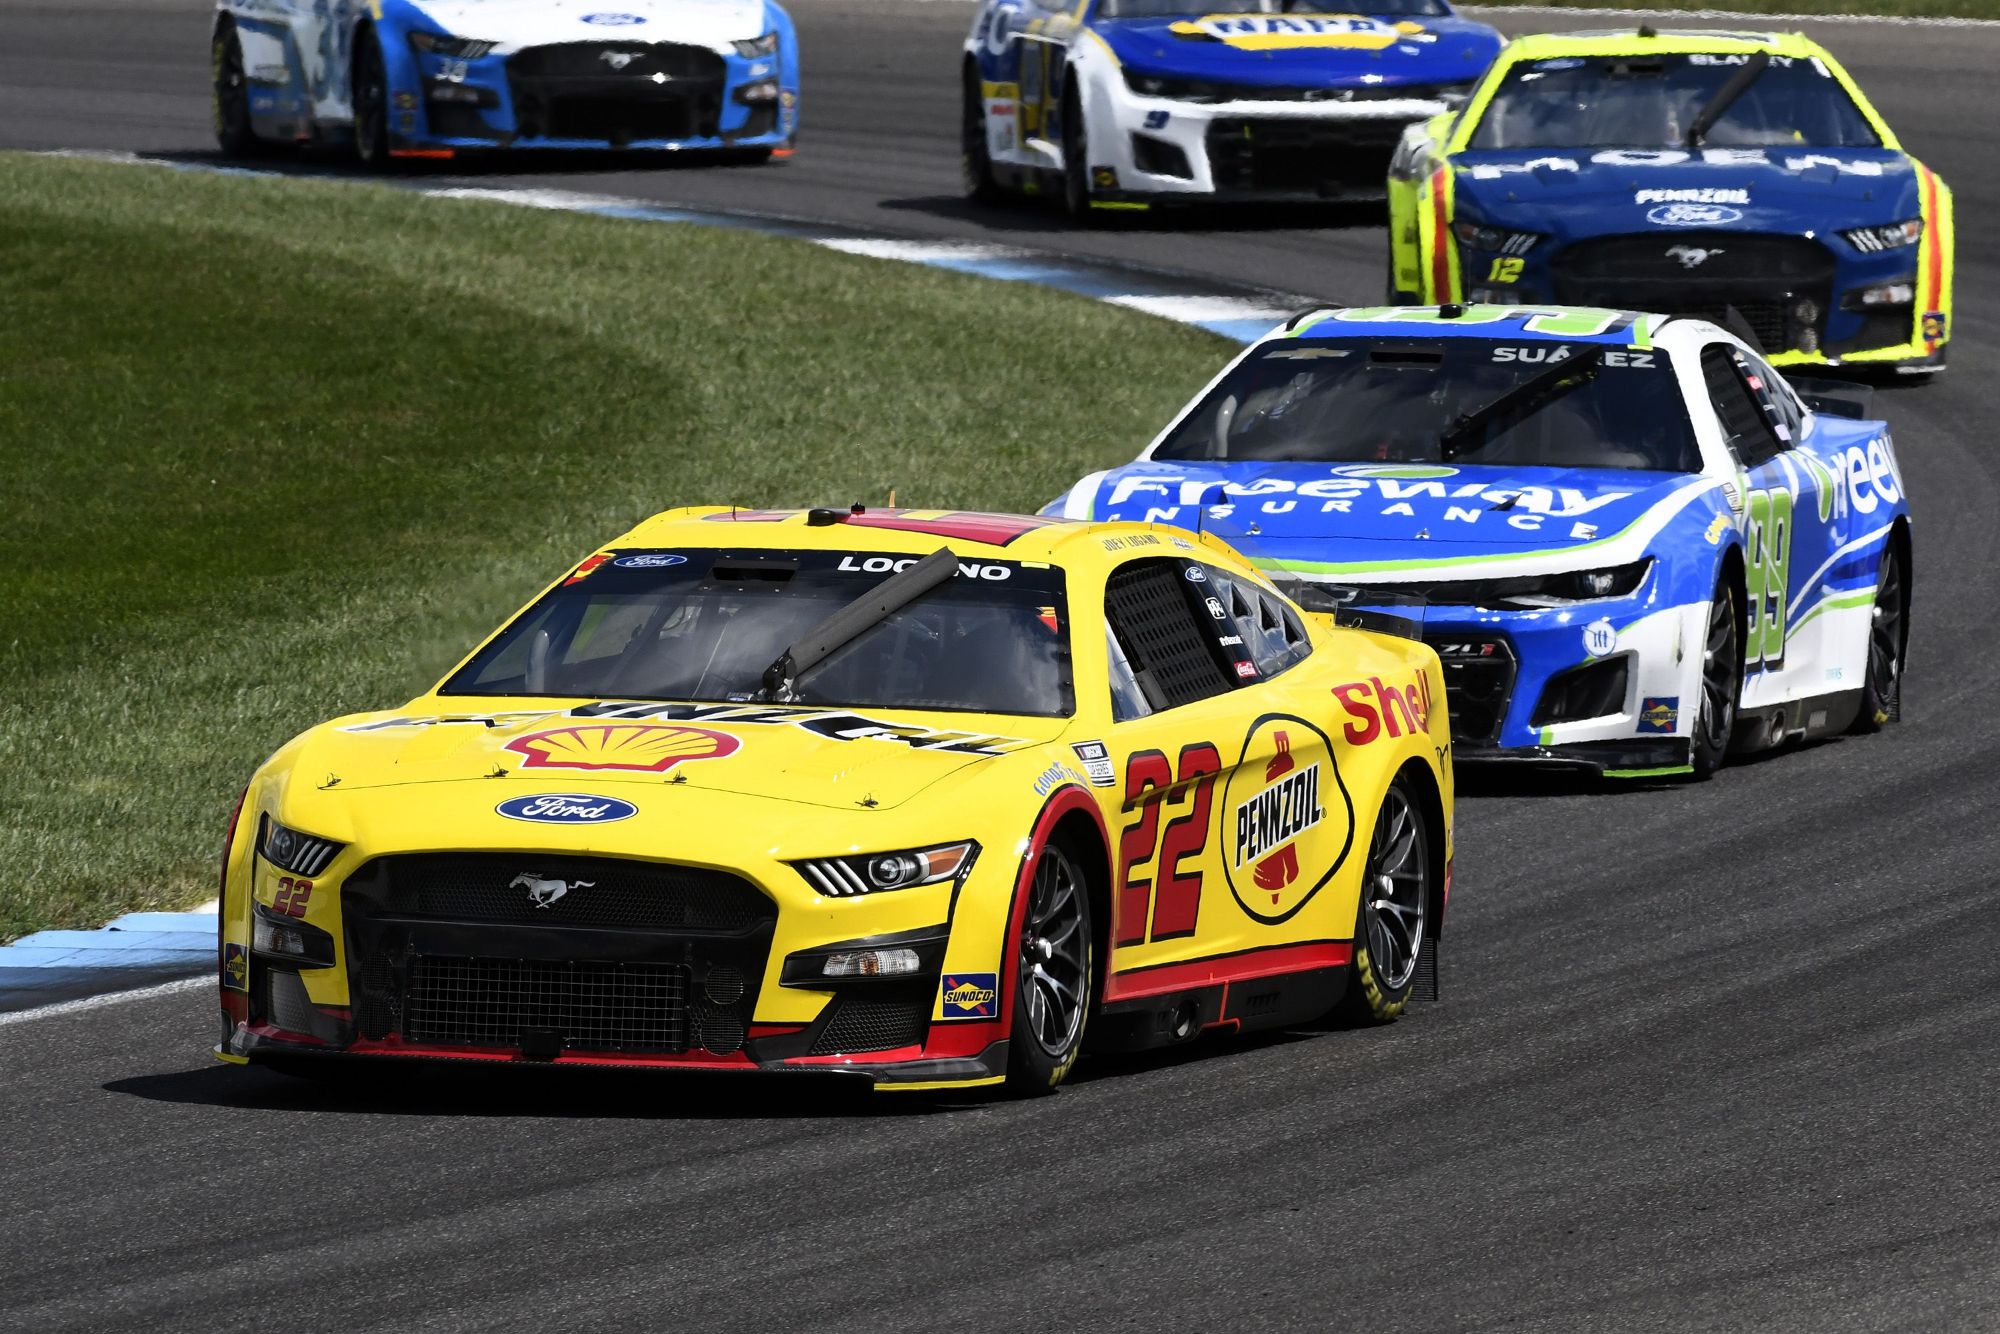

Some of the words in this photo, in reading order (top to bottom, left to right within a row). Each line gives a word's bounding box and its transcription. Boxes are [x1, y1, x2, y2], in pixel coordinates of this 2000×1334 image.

[1689, 54, 1793, 68] BLAY
[1145, 110, 1171, 129] 9
[1635, 187, 1751, 205] PENNZOIL
[1487, 257, 1525, 284] 12
[1491, 345, 1656, 369] SUÁEZ
[1102, 537, 1127, 552] JOEY
[1126, 534, 1161, 547] LOGANO
[837, 556, 1012, 581] LONO
[1744, 486, 1792, 671] 99
[1331, 668, 1432, 746] Shell
[521, 796, 611, 819] Ford
[1235, 764, 1321, 869] PENNZOIL
[1115, 740, 1222, 949] 22
[272, 876, 313, 918] 22
[944, 988, 994, 1004] SUNOCO
